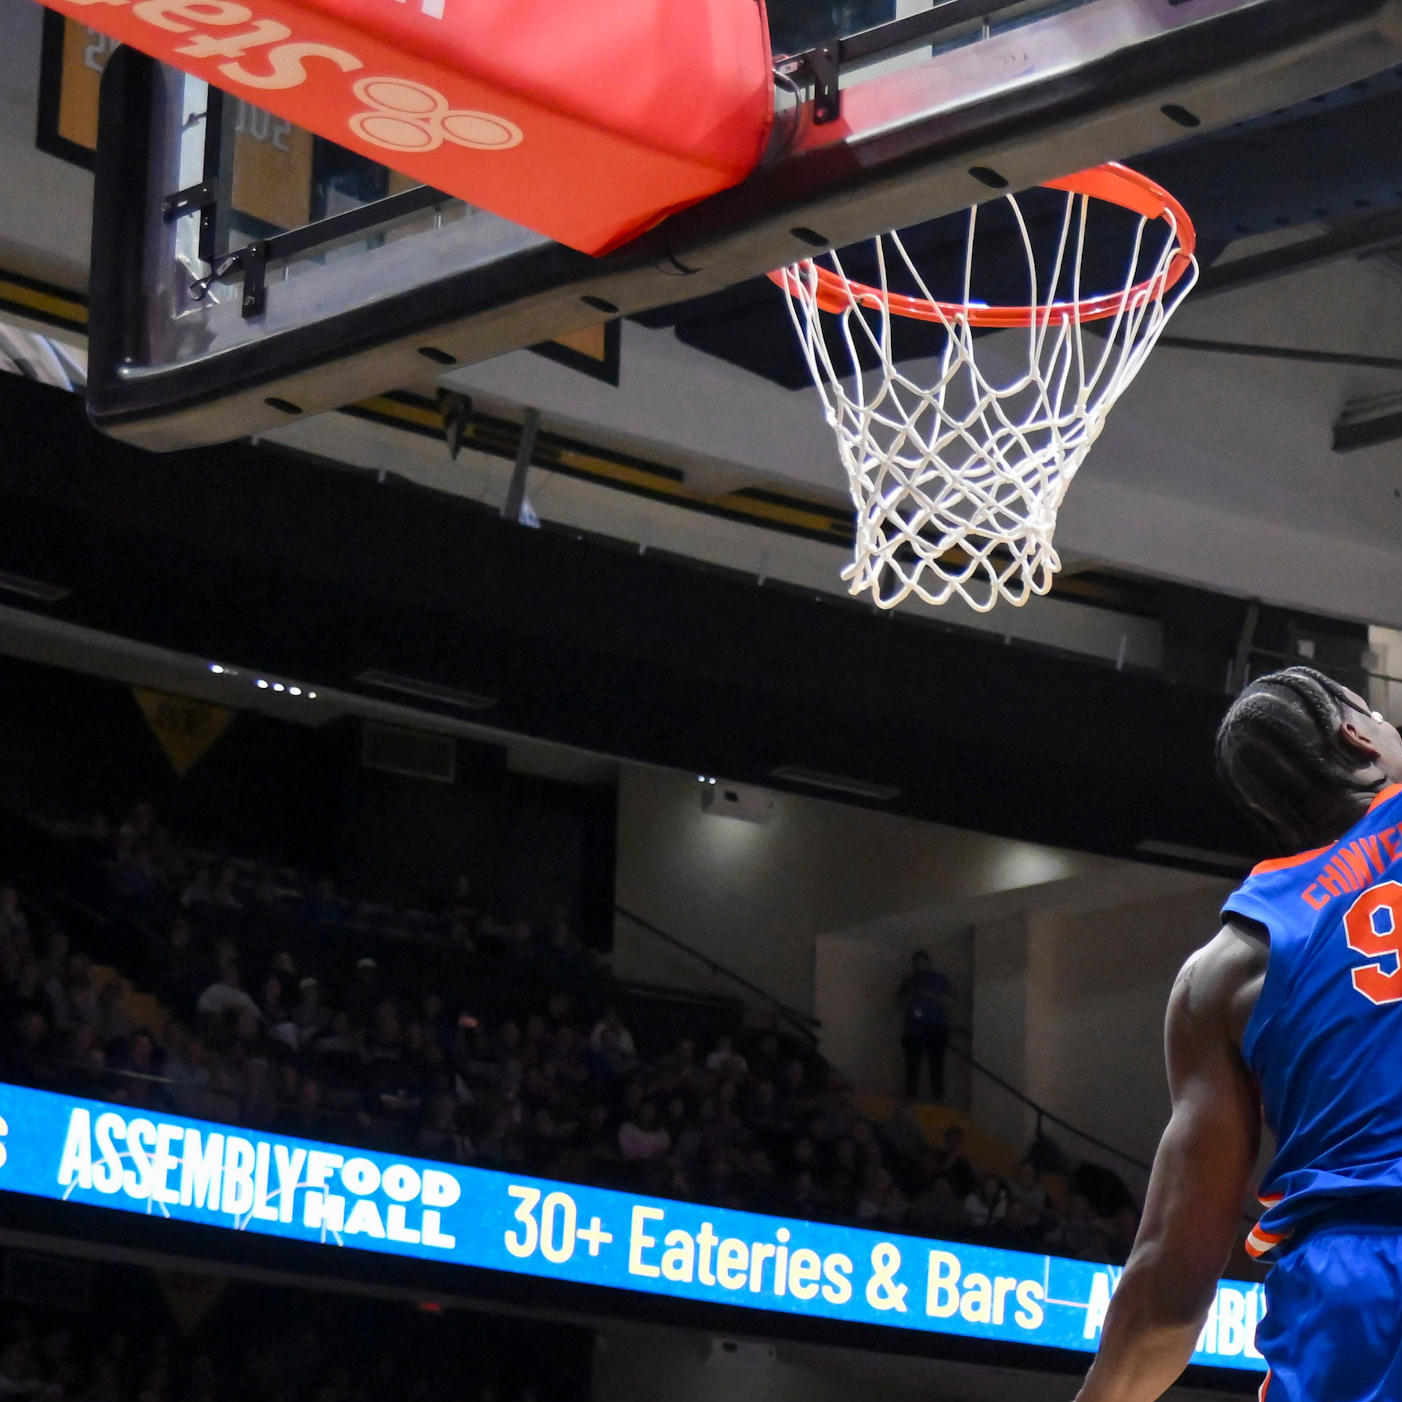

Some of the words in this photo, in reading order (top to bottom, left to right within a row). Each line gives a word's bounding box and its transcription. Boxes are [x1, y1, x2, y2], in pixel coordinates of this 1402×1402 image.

[57, 1107, 307, 1225] ASSEMBLY
[306, 1148, 462, 1210] FOOD
[303, 1191, 457, 1250] HALL
[503, 1184, 613, 1264] 30+
[627, 1205, 853, 1303] Eateries
[865, 1242, 908, 1312] &
[925, 1248, 1045, 1331] Bars
